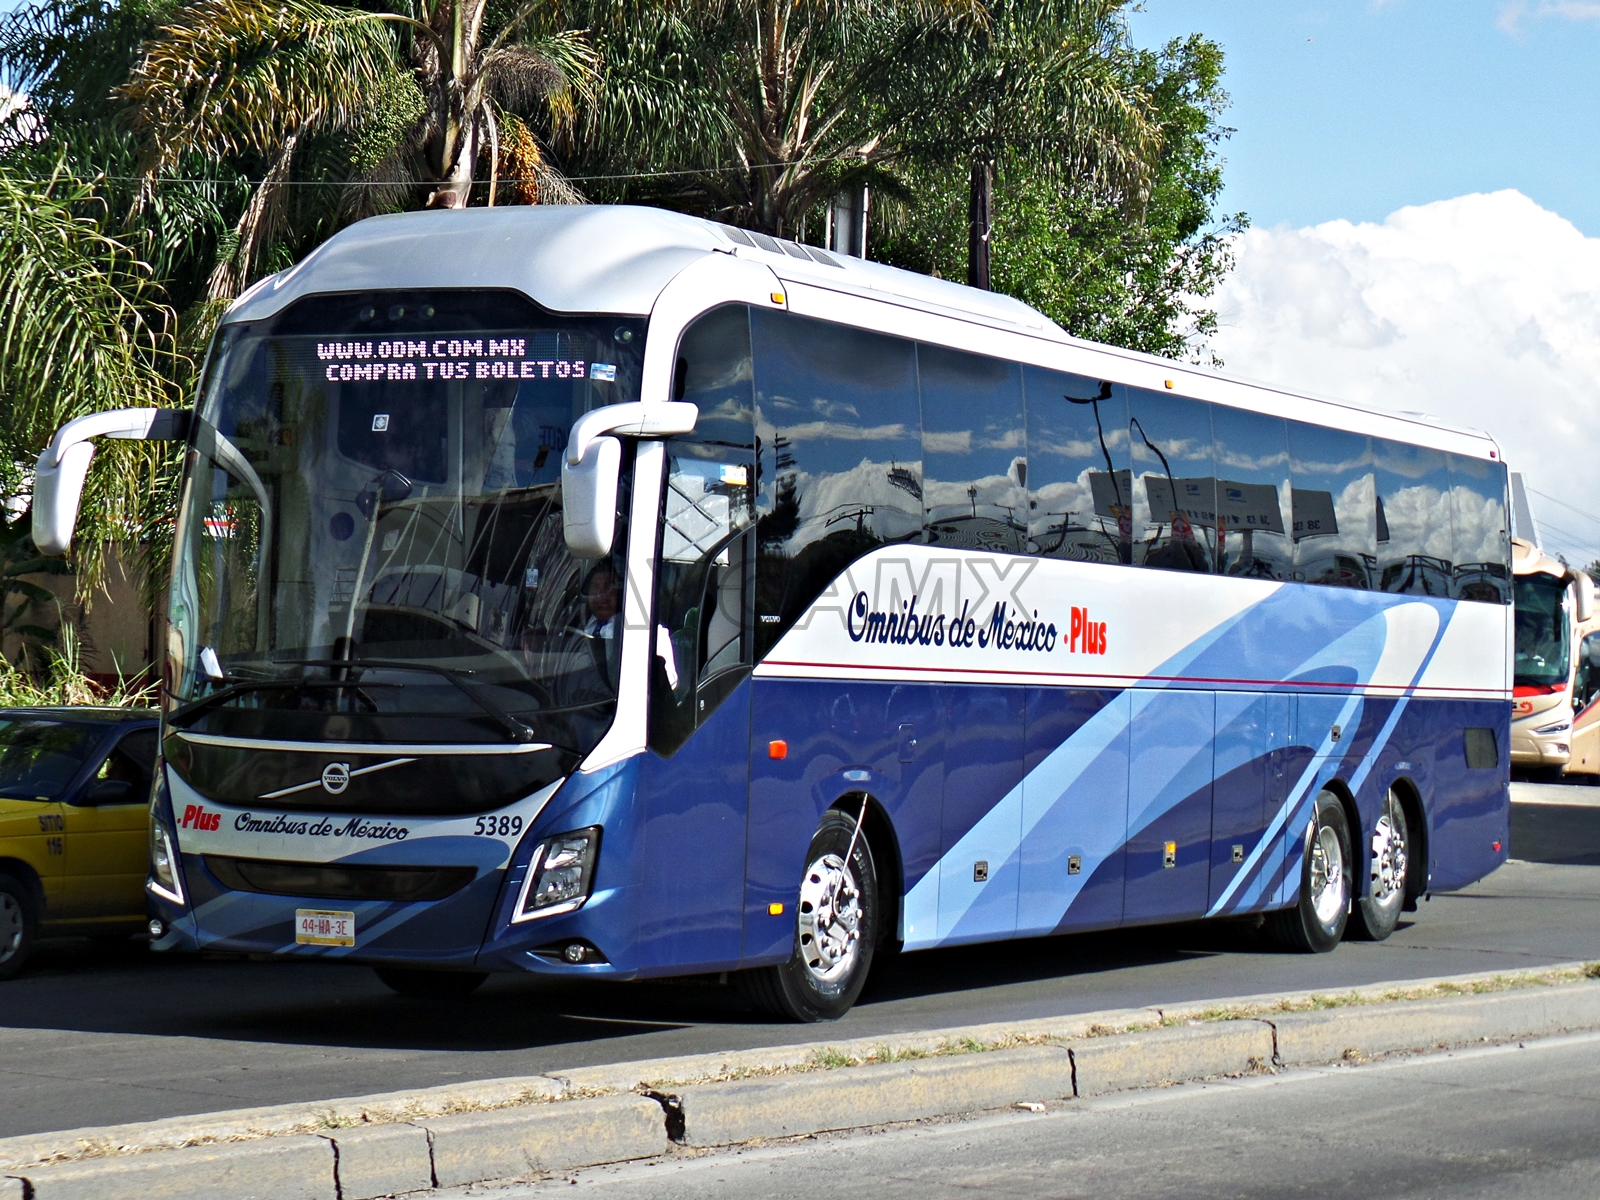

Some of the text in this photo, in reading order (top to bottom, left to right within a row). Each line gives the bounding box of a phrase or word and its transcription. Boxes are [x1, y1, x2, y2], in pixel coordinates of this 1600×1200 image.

[317, 338, 526, 360] WWW.ODM.COM.MX
[325, 362, 417, 382] COMPRA
[422, 361, 470, 380] TUS
[475, 360, 586, 379] BOLETOS
[760, 615, 781, 623] VOLVO
[848, 590, 946, 647] Omnibus
[949, 598, 976, 648] de
[978, 600, 1059, 653] México
[234, 812, 410, 840] Omnibus de México
[473, 815, 523, 837] 5389
[301, 918, 348, 936] 44-HA-3E
